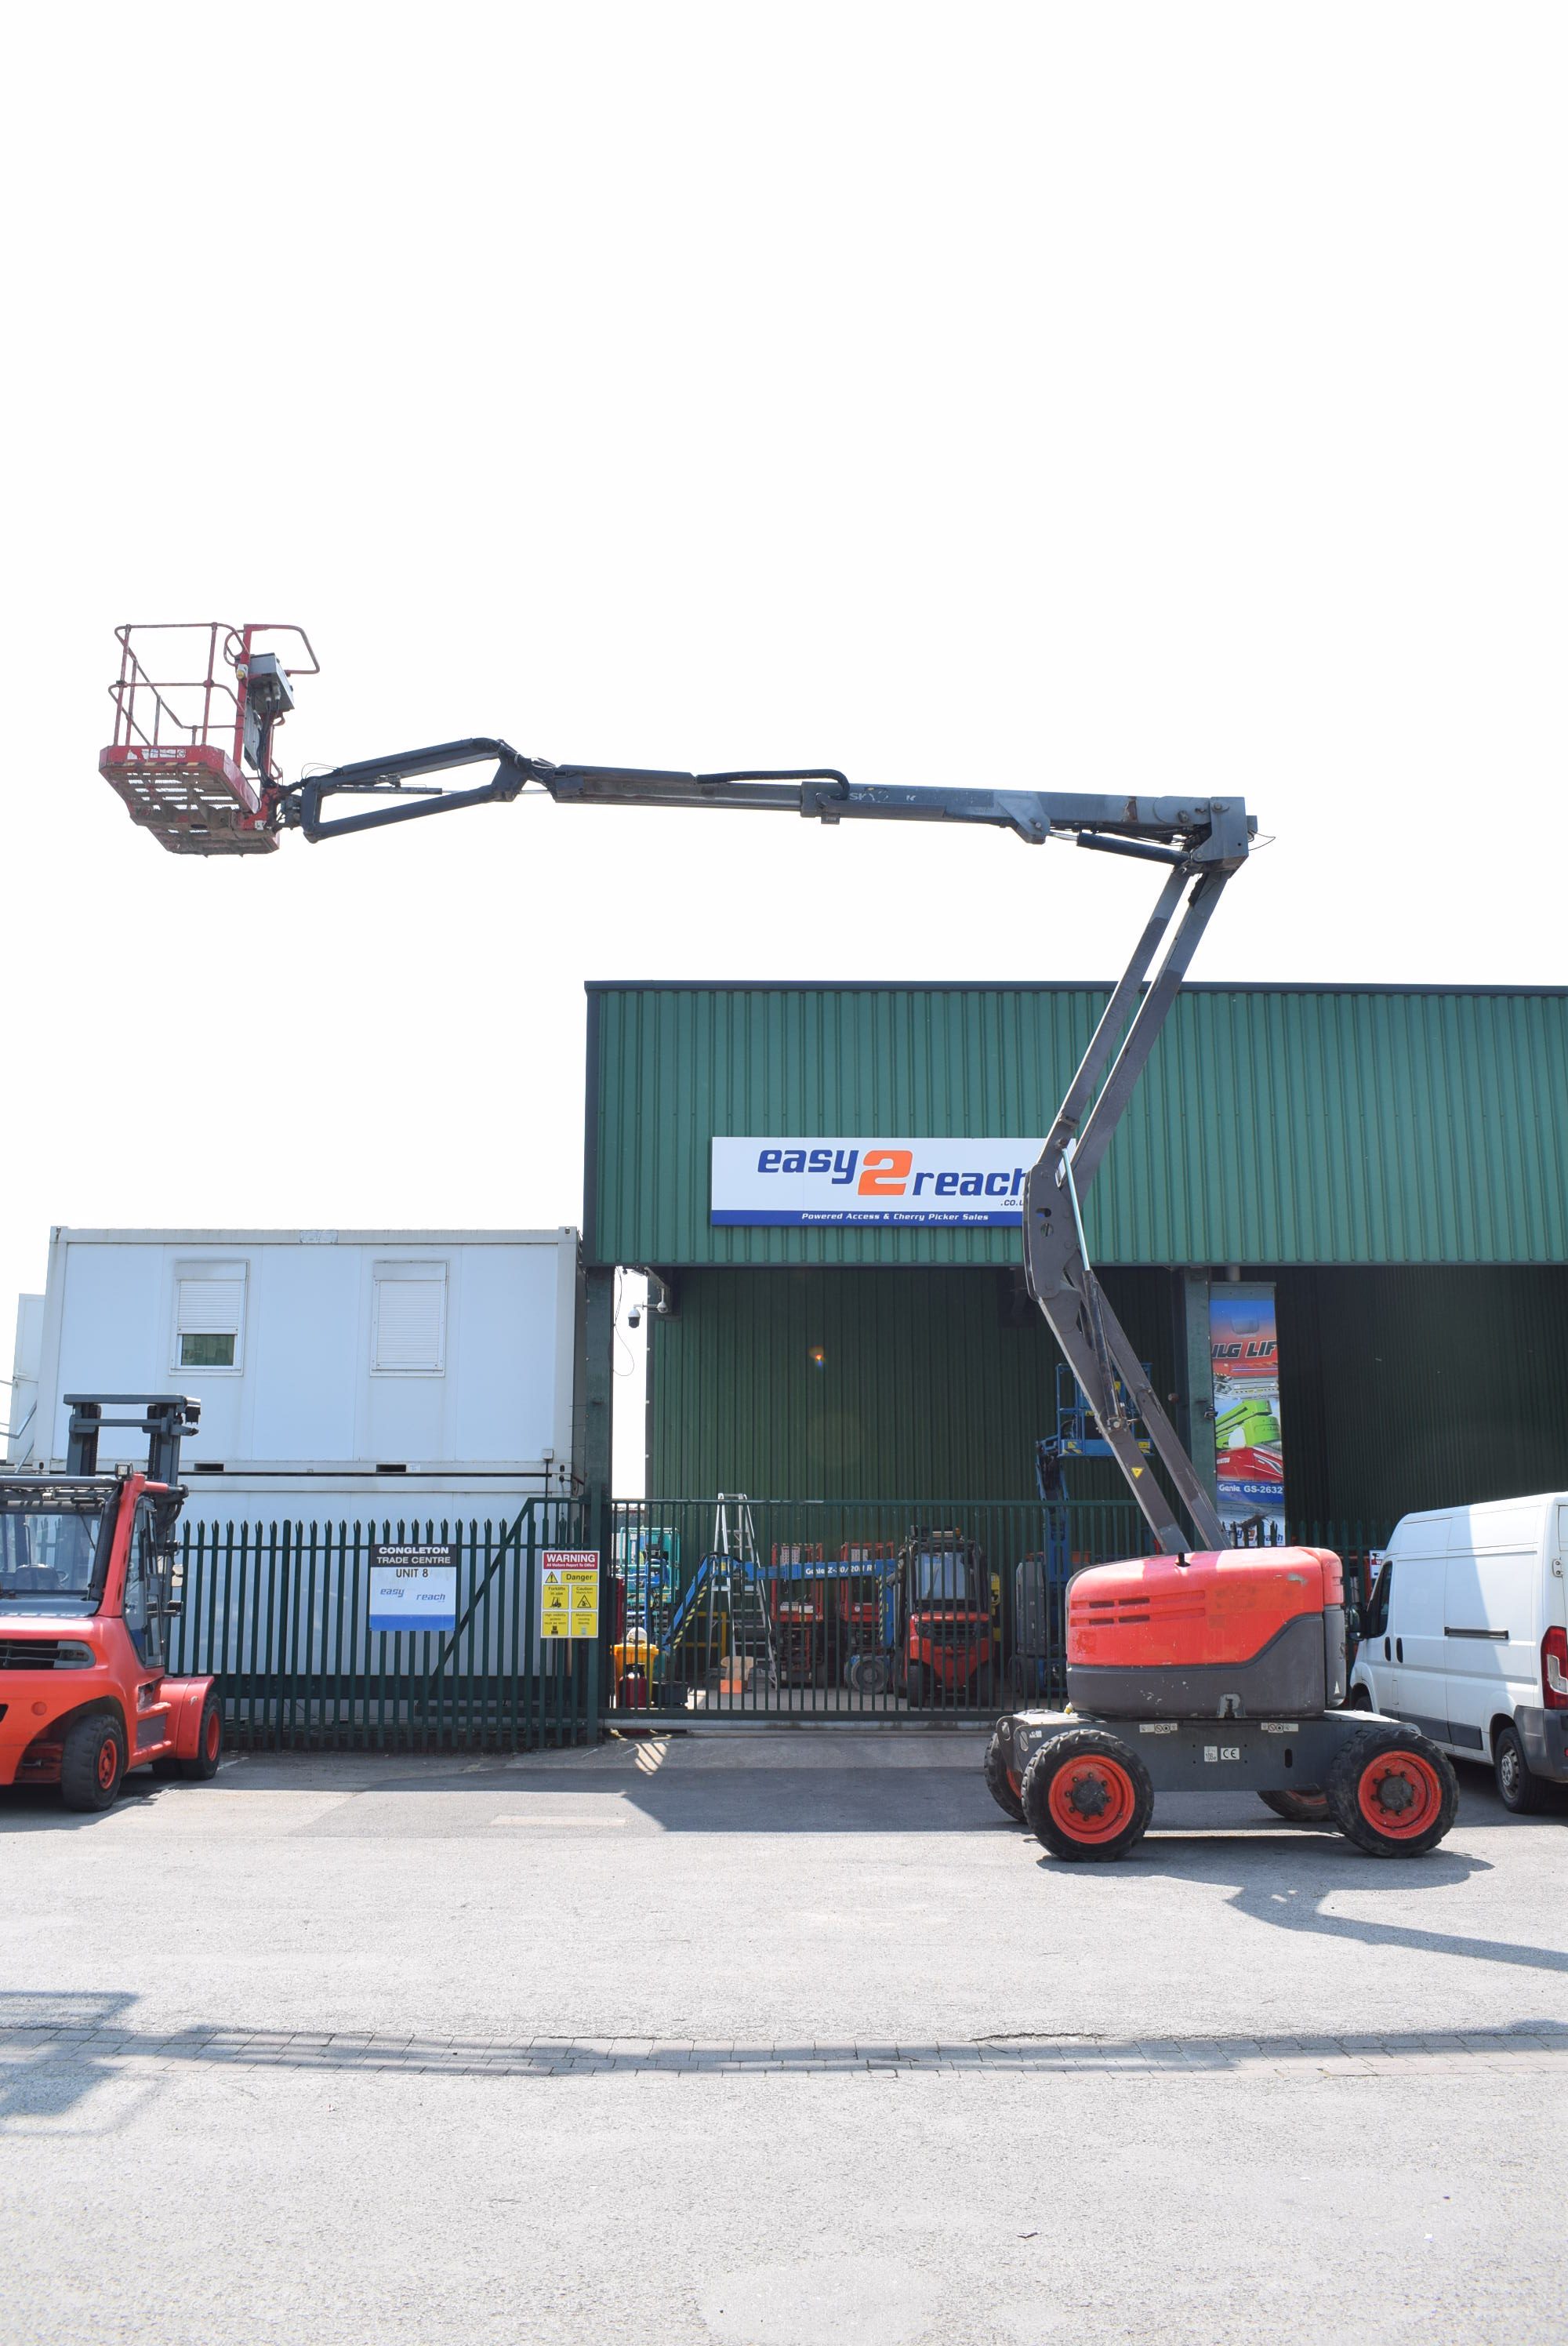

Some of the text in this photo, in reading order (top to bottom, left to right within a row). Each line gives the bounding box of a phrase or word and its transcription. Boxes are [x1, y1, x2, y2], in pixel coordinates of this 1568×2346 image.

[893, 1213, 924, 1222] Cherry
[1243, 1485, 1283, 1494] GS-2632
[546, 1554, 596, 1563] WARNING
[396, 1568, 428, 1578] UNIT 8
[380, 1589, 405, 1597] easy
